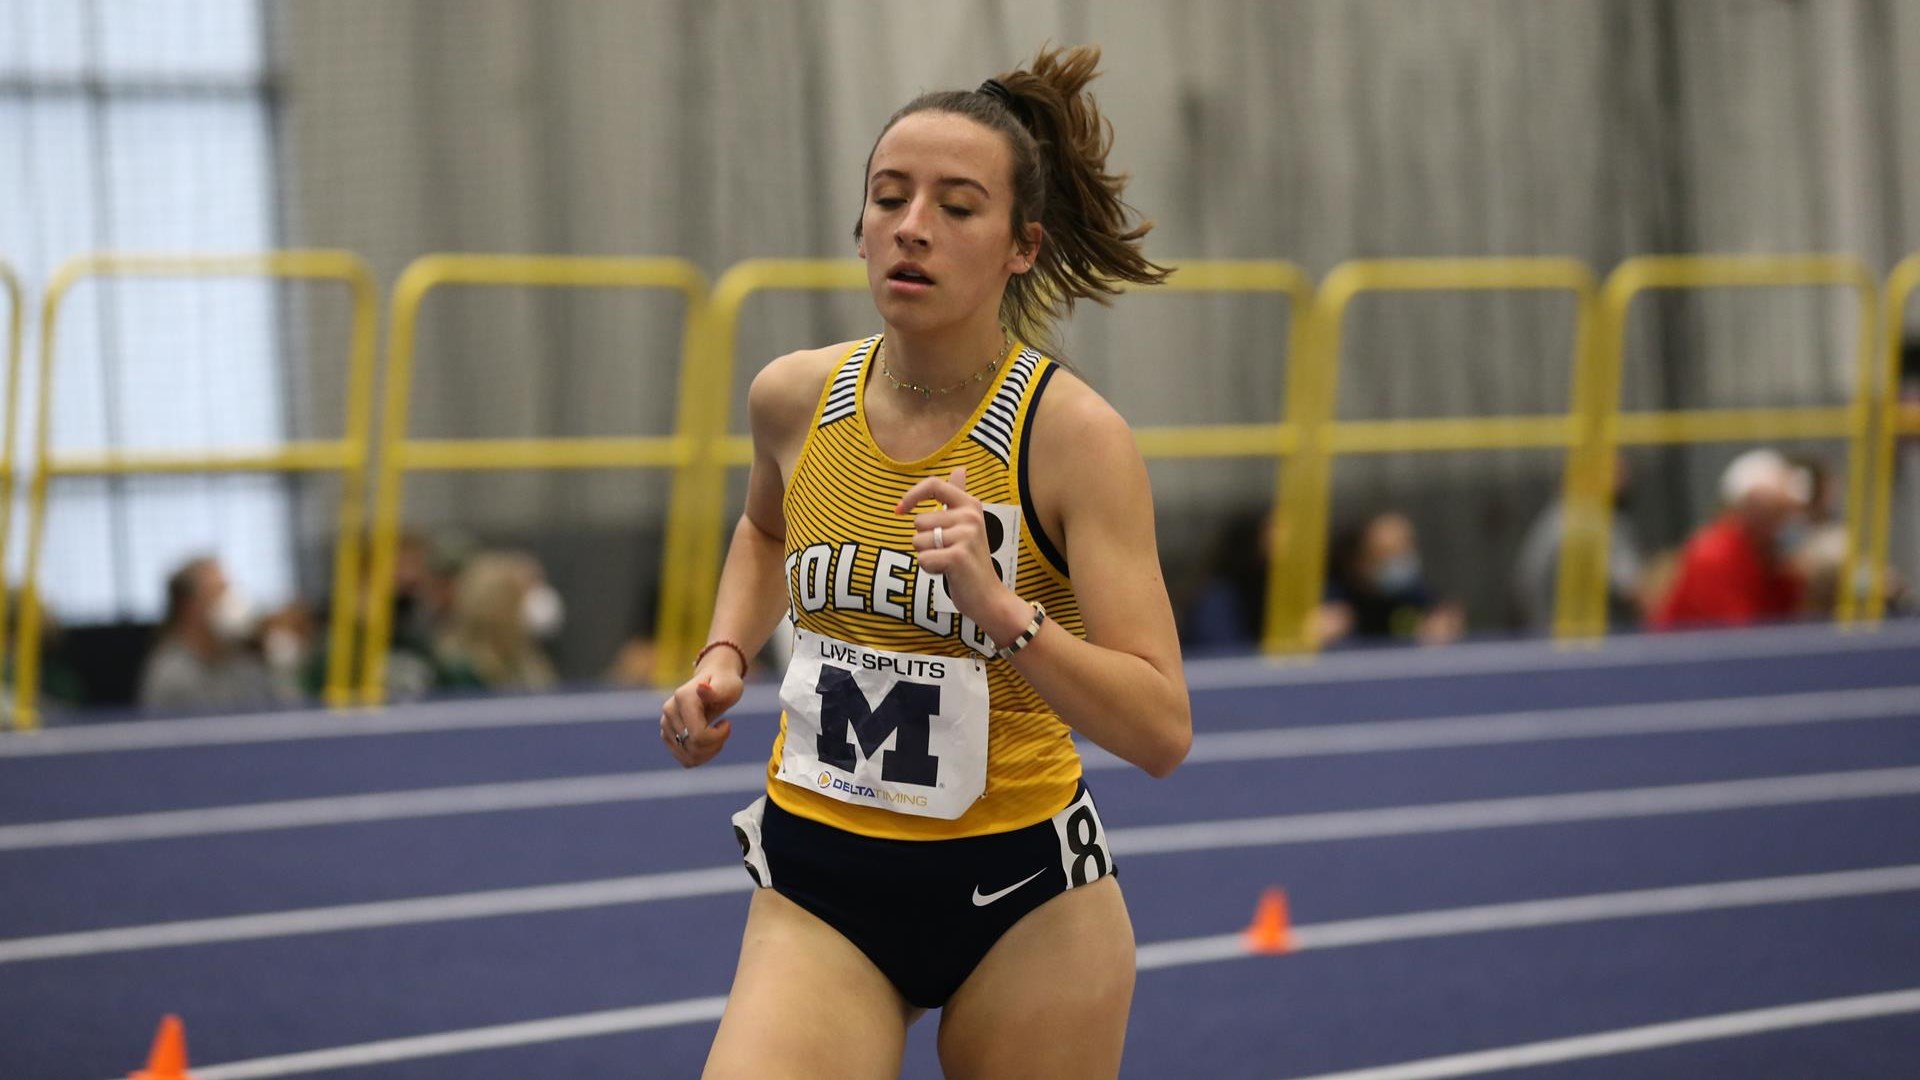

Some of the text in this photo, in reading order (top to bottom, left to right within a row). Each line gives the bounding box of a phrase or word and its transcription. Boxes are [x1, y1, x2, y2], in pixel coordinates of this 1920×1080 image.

[820, 641, 946, 679] LIVE SPLITS
[816, 663, 941, 788] M
[832, 778, 928, 807] DELTATIMING
[1066, 805, 1107, 888] 8
